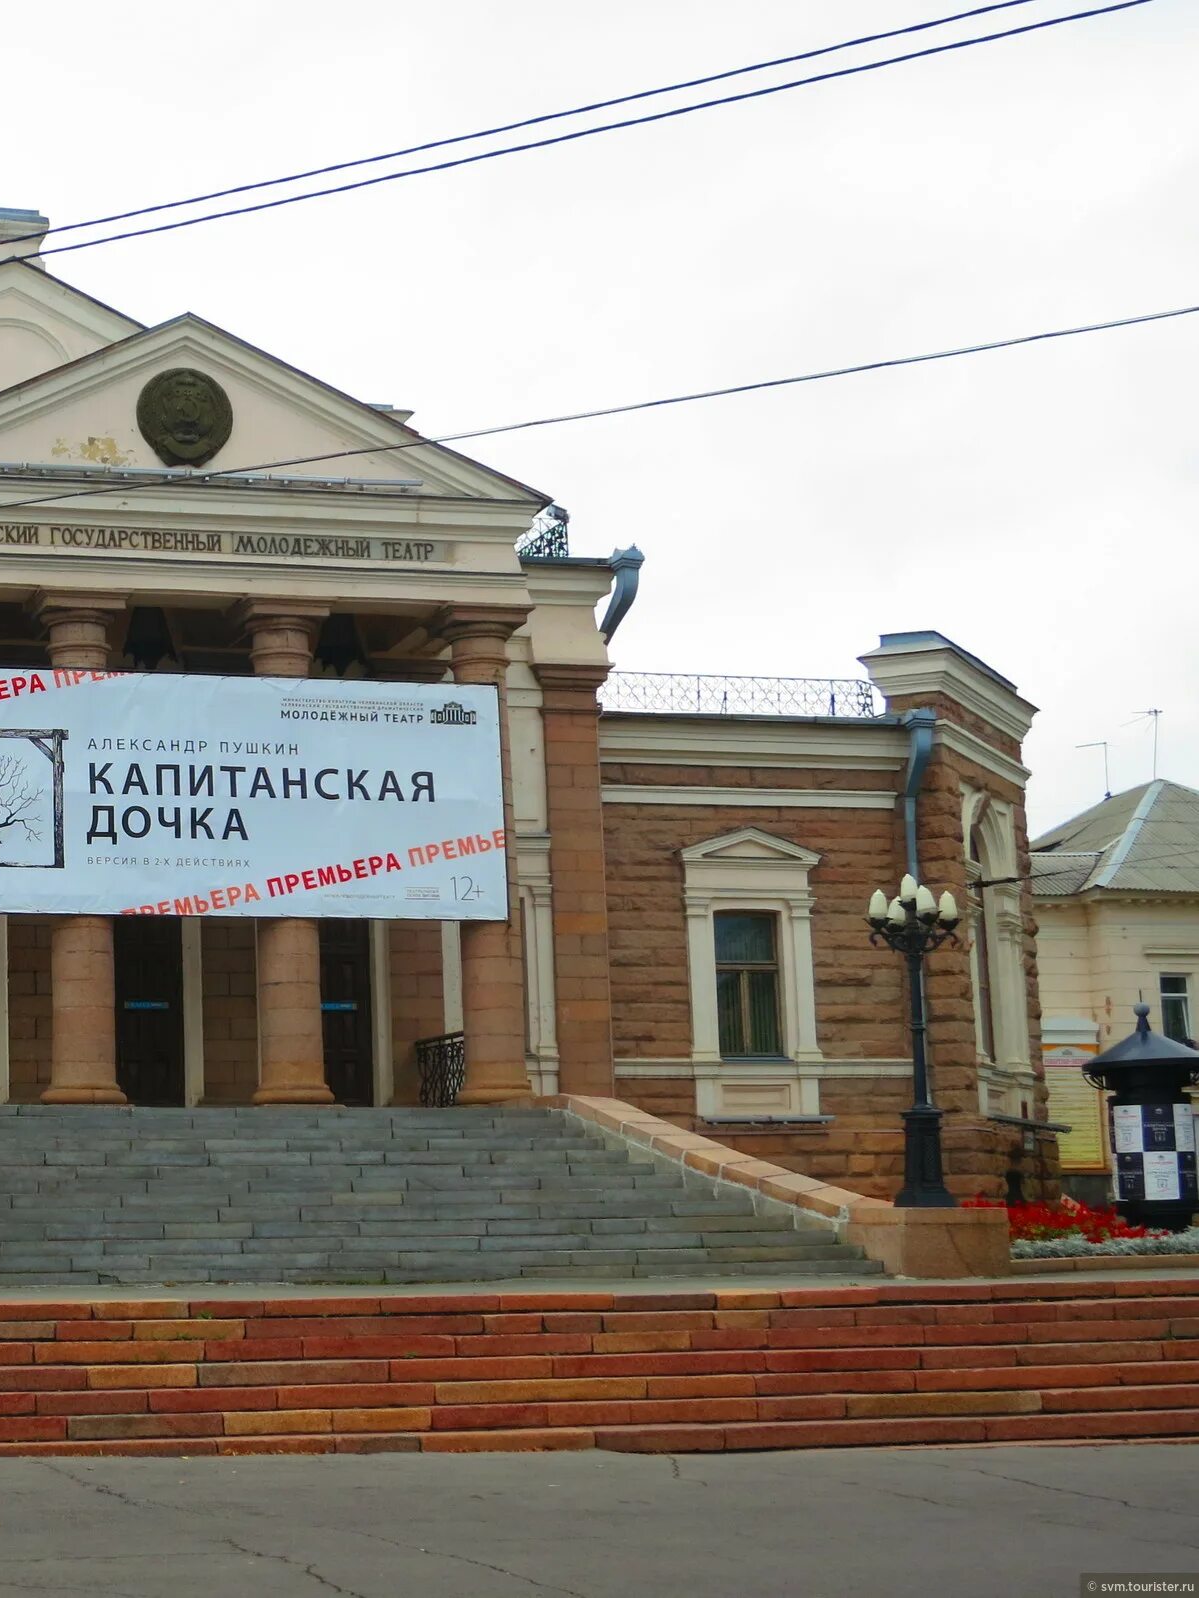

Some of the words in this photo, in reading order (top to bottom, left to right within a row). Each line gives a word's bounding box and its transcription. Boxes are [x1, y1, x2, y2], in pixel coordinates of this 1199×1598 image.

[50, 527, 222, 553] ГОСУДАРСТВЕННЫЙ
[234, 535, 371, 558] МОЛОДЕЖНЫЙ
[381, 541, 434, 560] ТЕАТР
[280, 709, 378, 722] МОЛОДЁЖНЫЙ
[384, 713, 424, 723] ТЕАТР
[87, 738, 208, 754] АЛЕКСАНДР
[220, 741, 299, 755] ПУШКИН
[88, 762, 435, 802] КАПИТАНСКАЯ
[86, 805, 249, 845] ДОЧКА
[87, 856, 137, 865] ВЕРСИЯ
[143, 857, 150, 866] В
[155, 857, 171, 866] 2-Х
[176, 856, 250, 867] ДЕЙСТВИЯХ
[266, 852, 401, 897] ПРЕМЬЕРА
[408, 829, 505, 867] ПРЕМЬЕ
[450, 875, 485, 901] 12+
